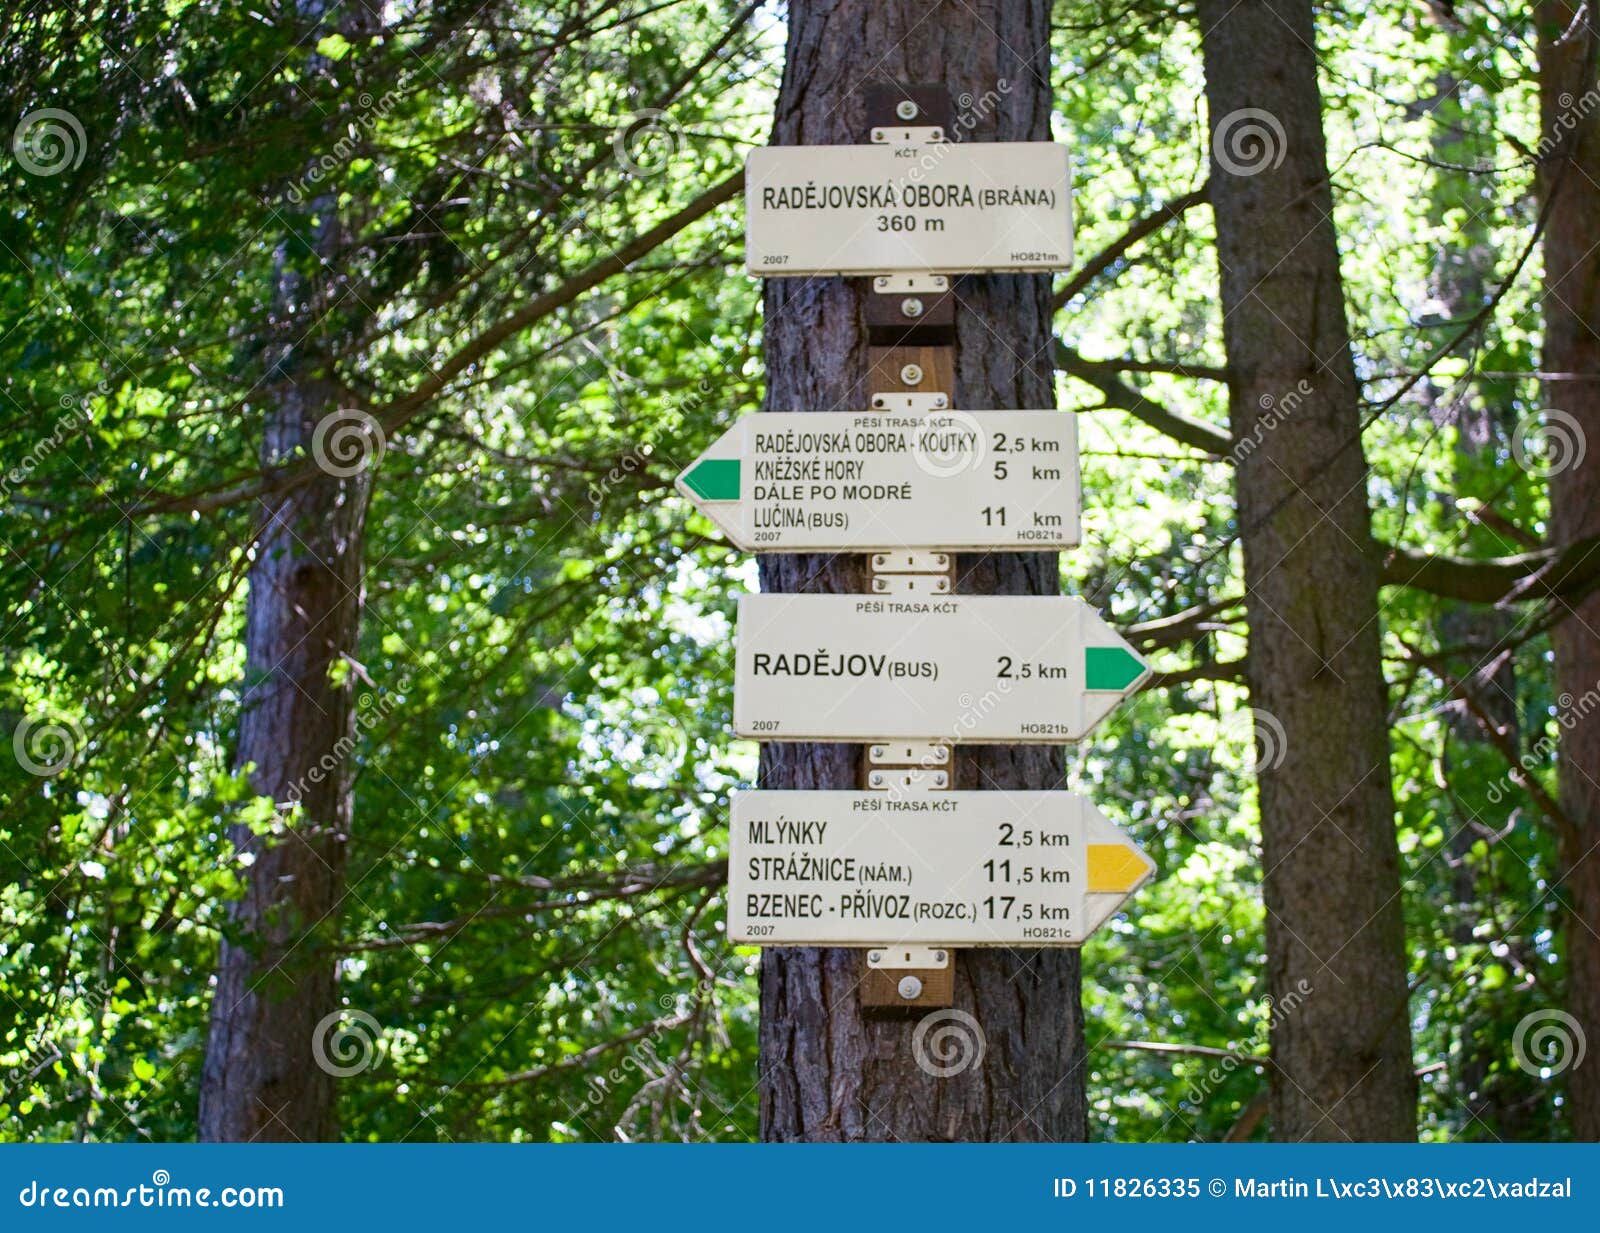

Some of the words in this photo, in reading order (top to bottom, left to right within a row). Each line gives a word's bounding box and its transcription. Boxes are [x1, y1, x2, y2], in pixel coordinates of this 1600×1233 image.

[895, 148, 917, 158] KČT
[763, 180, 896, 210] RADĚJOVSKÁ
[902, 184, 974, 208] OBORA
[978, 188, 1056, 210] (BRÁNA)
[877, 216, 916, 232] 360
[925, 218, 945, 232] m
[763, 255, 788, 265] 2007
[1011, 253, 1058, 262] HO821m
[886, 418, 926, 427] TRASA
[756, 429, 851, 453] RADĚJOVSKÁ
[855, 433, 906, 453] OBORA
[919, 433, 977, 452] KOUTKY
[992, 433, 1024, 454] 2,5
[1032, 437, 1059, 452] km
[755, 456, 821, 480] KNĚŽSKÉ
[824, 461, 864, 480] HORY
[994, 461, 1008, 480] 5
[1032, 466, 1060, 480] km
[754, 482, 804, 500] DÁLE
[810, 486, 836, 500] PO
[843, 482, 911, 500] MODRÉ
[754, 504, 805, 527] LUČINA
[808, 512, 849, 530] (BUS)
[981, 507, 1007, 526] 11
[1034, 512, 1062, 526] km
[755, 532, 781, 541] 2007
[1017, 530, 1062, 540] HO821a
[889, 604, 929, 613] TRASA
[933, 603, 958, 613] KČT
[753, 649, 886, 676] RADĚJOV
[888, 662, 938, 681] (BUS)
[997, 657, 1031, 680] 2,5
[1038, 664, 1067, 678] km
[752, 721, 779, 730] 2007
[1021, 724, 1068, 734] HO821b
[885, 801, 928, 811] TRASA
[932, 801, 958, 811] KČT
[749, 816, 827, 844] MLÝNKY
[998, 824, 1033, 848] 2,5
[1040, 832, 1069, 846] km
[749, 852, 855, 881] STRÁŽNICE
[859, 864, 912, 885] (NÁM.)
[983, 860, 1033, 885] 11,5
[1041, 869, 1070, 883] km
[747, 894, 823, 918] BZENEC
[841, 890, 910, 919] PŘÍVOZ
[914, 903, 977, 922] (ROZC.)
[983, 896, 1032, 921] 17,5
[1040, 905, 1069, 919] km
[747, 925, 774, 936] 2007
